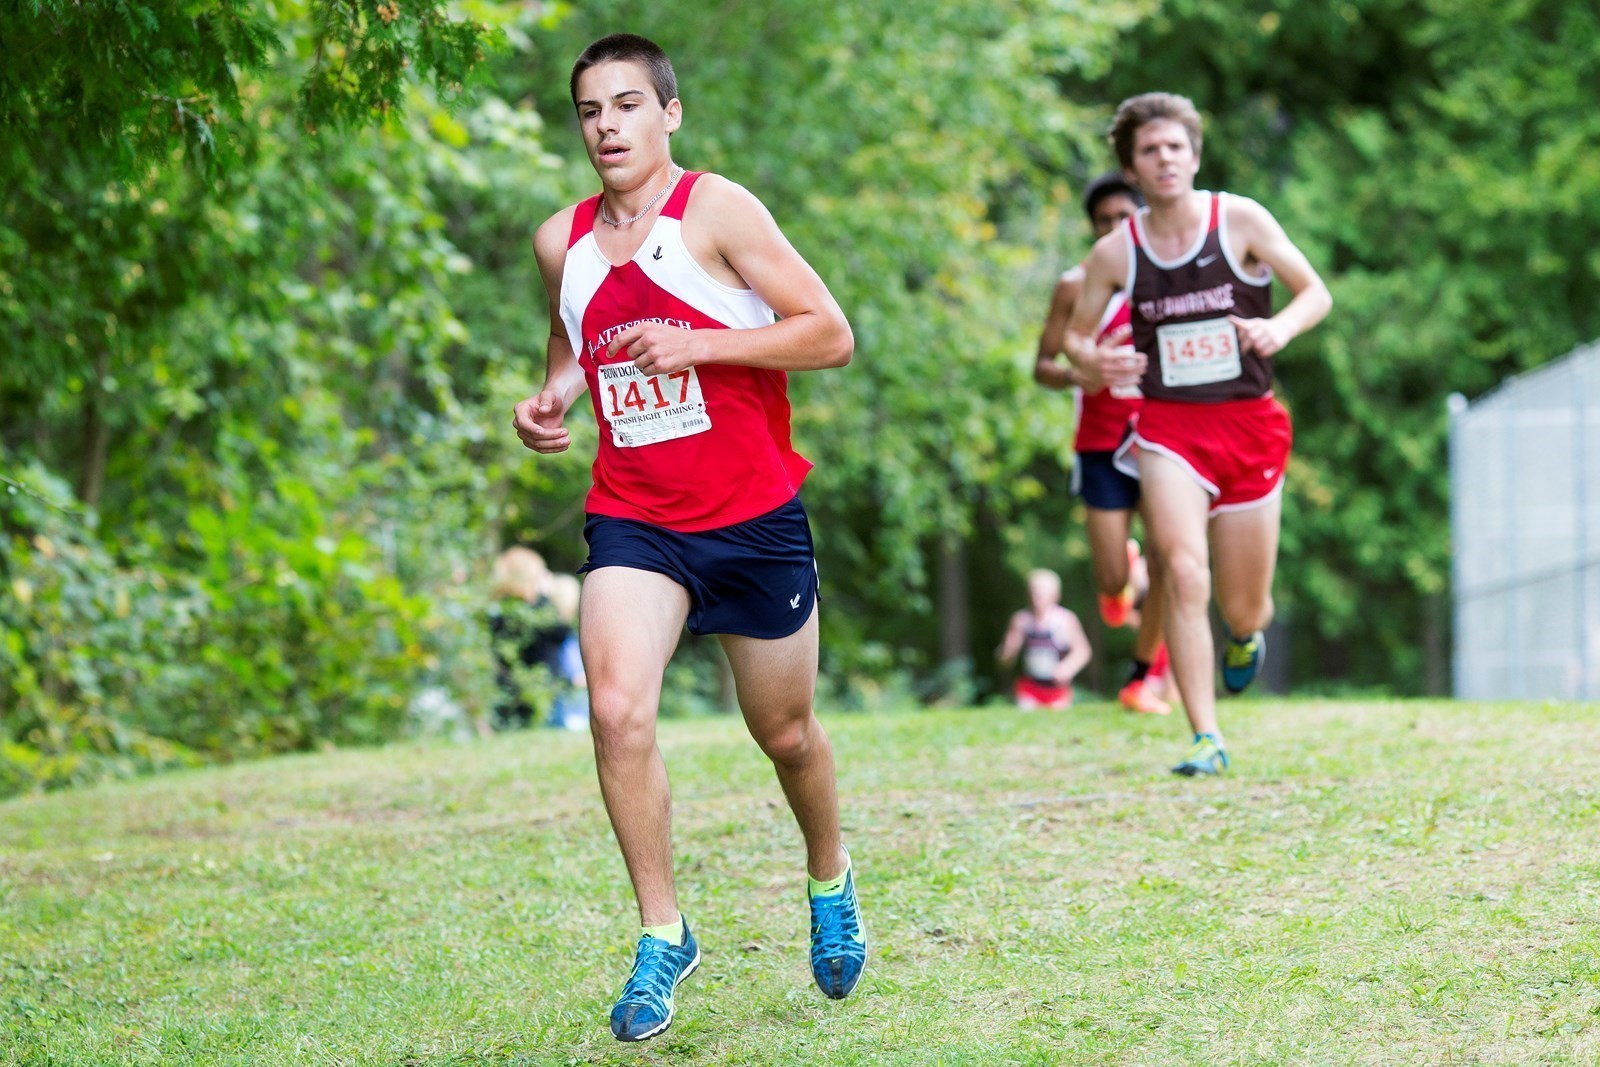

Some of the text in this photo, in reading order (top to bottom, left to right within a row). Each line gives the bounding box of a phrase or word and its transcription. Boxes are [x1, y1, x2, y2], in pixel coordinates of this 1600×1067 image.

[1166, 333, 1232, 364] 1453
[607, 369, 690, 416] 1417
[613, 404, 694, 427] FINISH RIGHT TIMING
